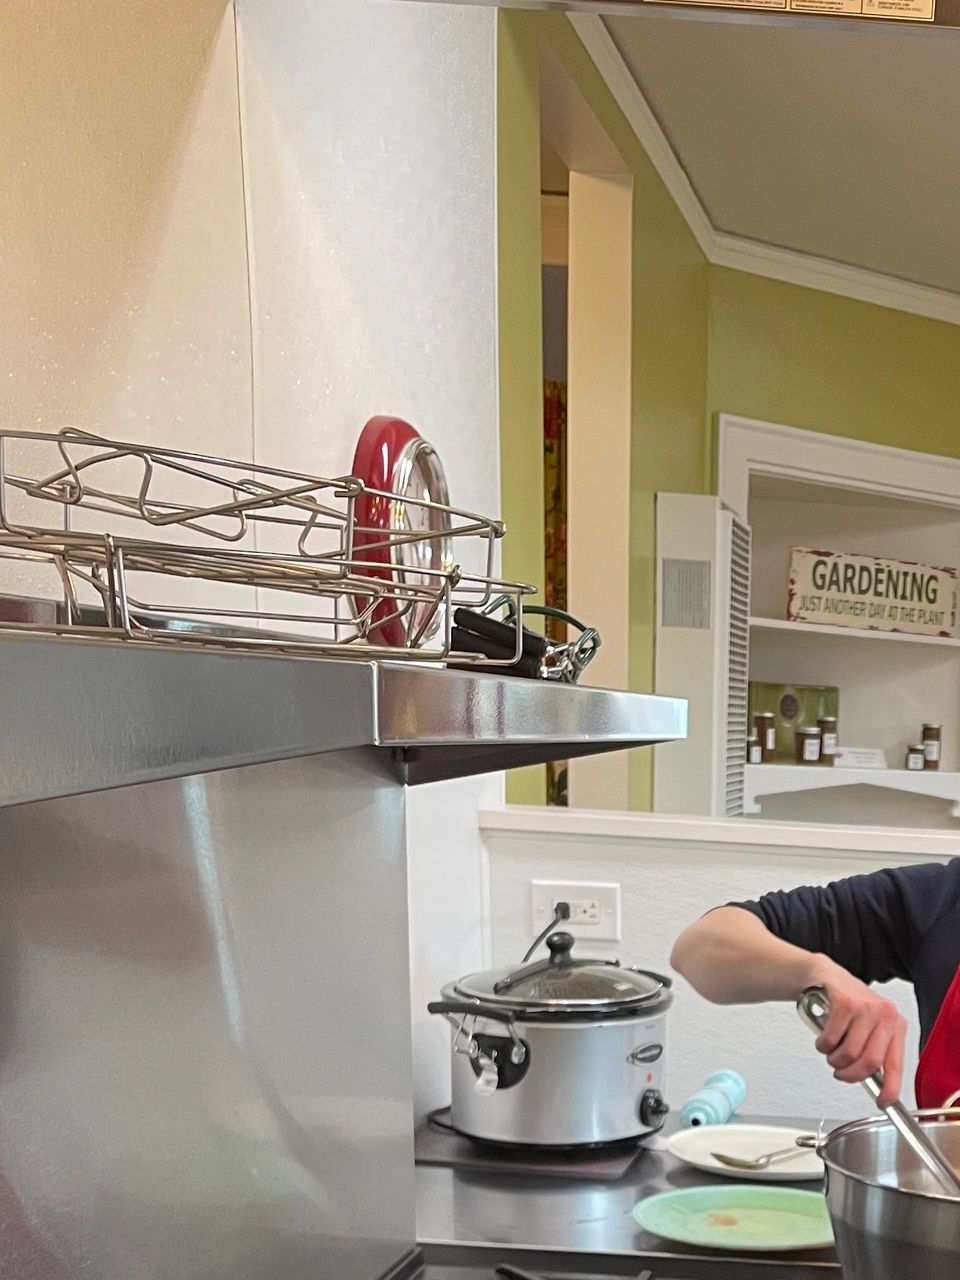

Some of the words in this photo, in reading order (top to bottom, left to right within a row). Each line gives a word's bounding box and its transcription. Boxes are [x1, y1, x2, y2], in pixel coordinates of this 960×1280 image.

[812, 560, 938, 604] GARDENING
[798, 595, 823, 612] JUST
[823, 597, 867, 617] ANOTHER
[868, 602, 886, 619] DAY
[886, 605, 900, 621] AT
[900, 606, 917, 623] THE
[917, 608, 945, 626] PLANT
